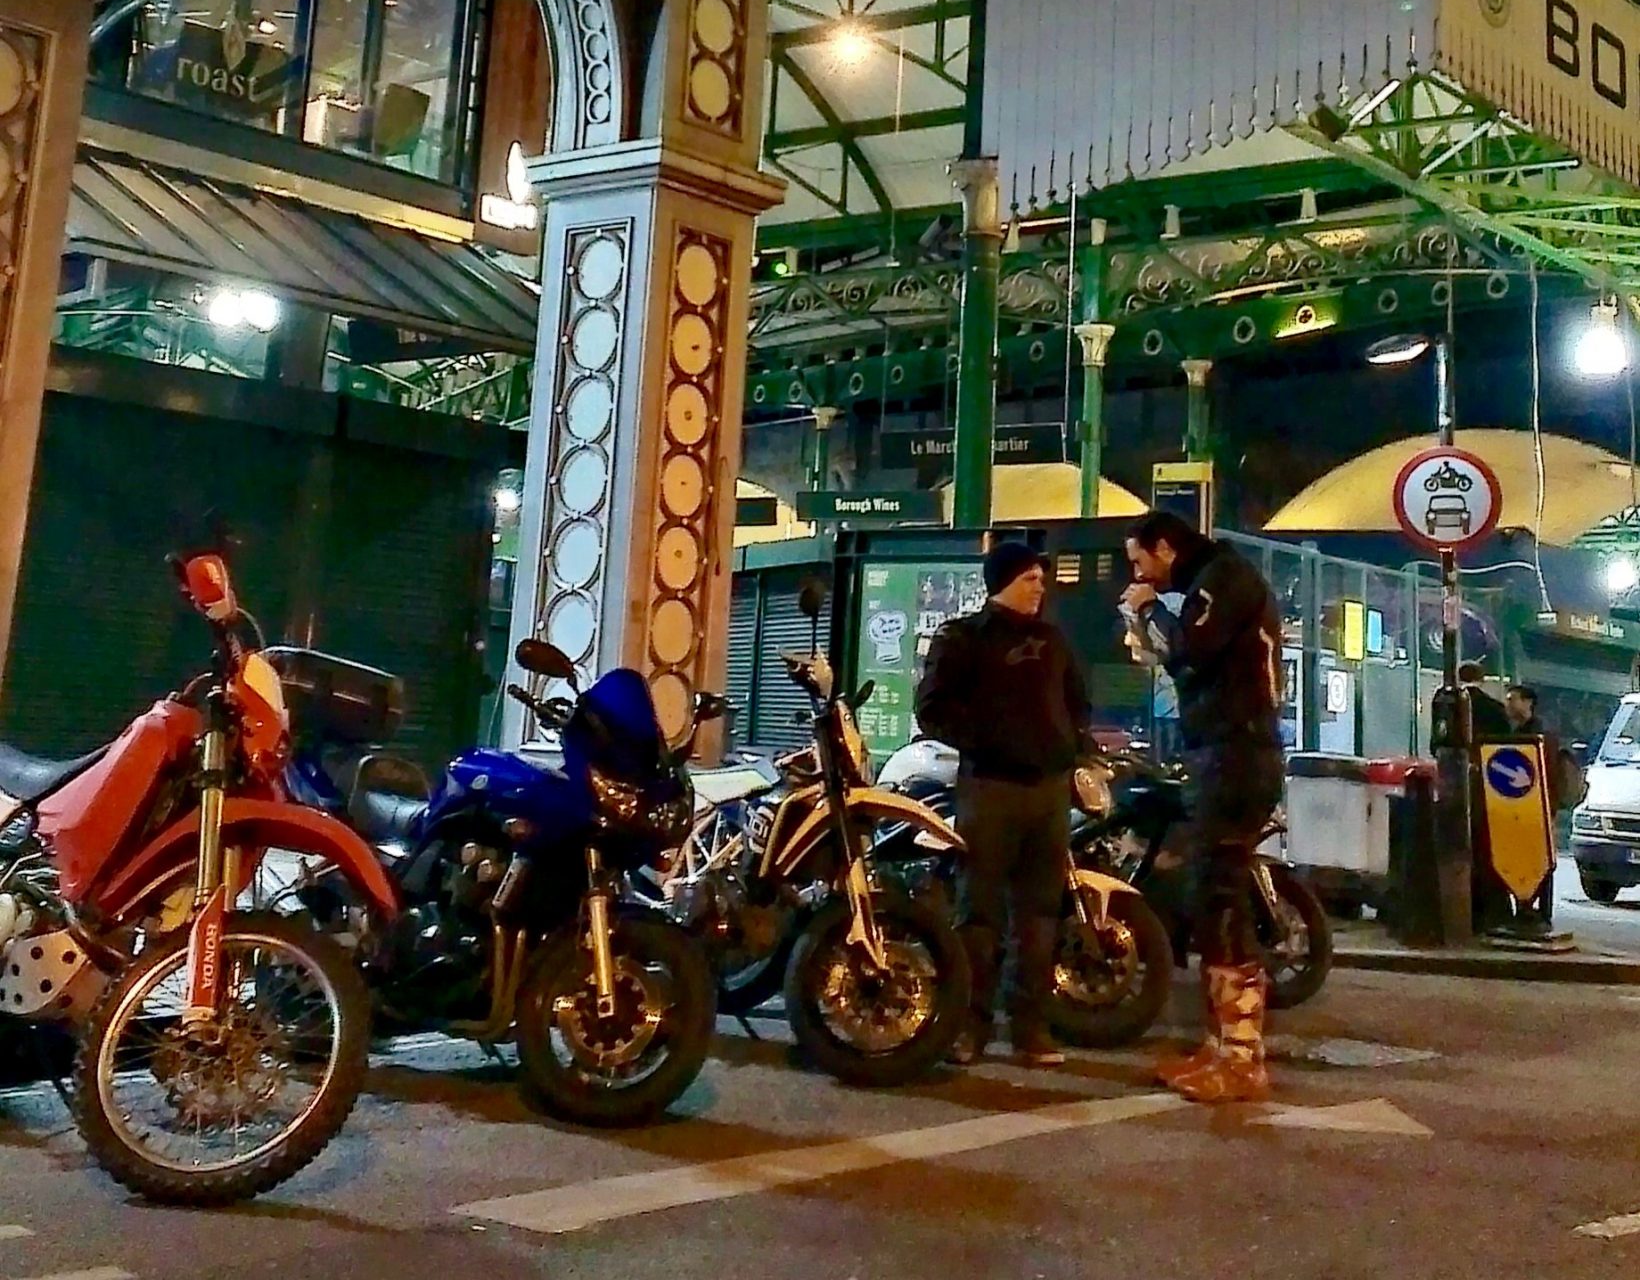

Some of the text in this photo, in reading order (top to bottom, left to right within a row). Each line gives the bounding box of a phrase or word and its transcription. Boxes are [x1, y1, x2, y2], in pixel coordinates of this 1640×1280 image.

[177, 57, 266, 102] roast
[910, 437, 1029, 455] Le Marc artier
[835, 497, 900, 513] Borough Wines
[201, 923, 217, 989] HONDA
